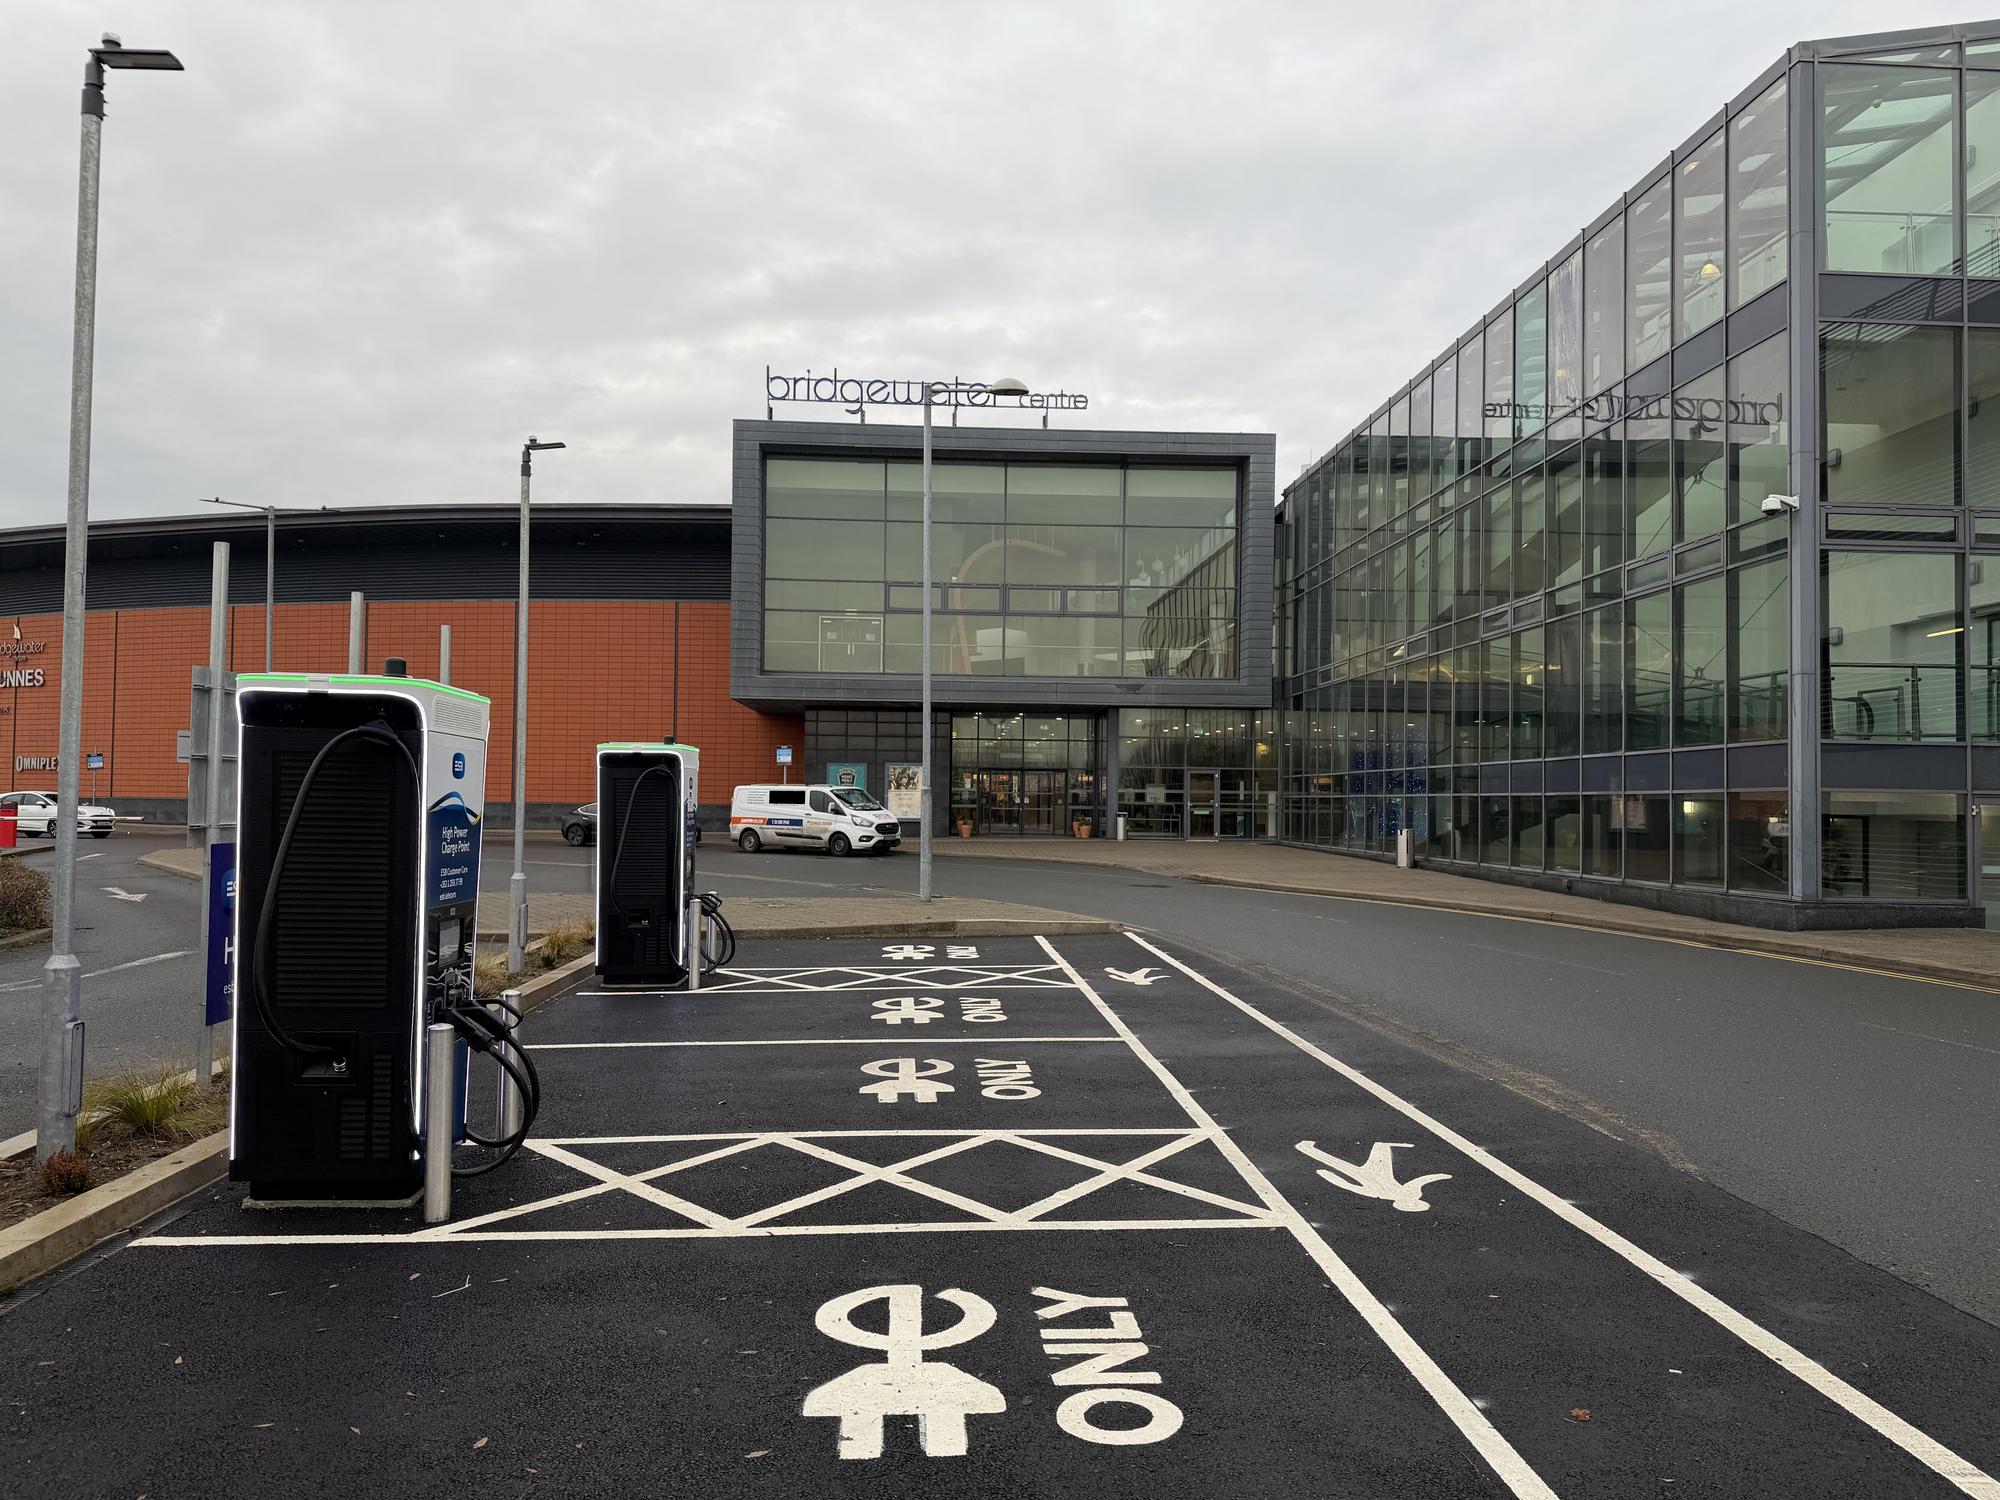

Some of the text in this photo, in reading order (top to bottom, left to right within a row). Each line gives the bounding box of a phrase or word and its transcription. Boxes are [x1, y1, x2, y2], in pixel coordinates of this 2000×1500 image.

[1019, 389, 1089, 409] centre
[441, 826, 468, 842] High Power
[441, 840, 470, 857] Charge Point
[946, 945, 980, 960] ONLY
[959, 996, 1008, 1023] ONLY
[974, 1058, 1042, 1100] ONLY
[1031, 1286, 1184, 1445] ONLY
